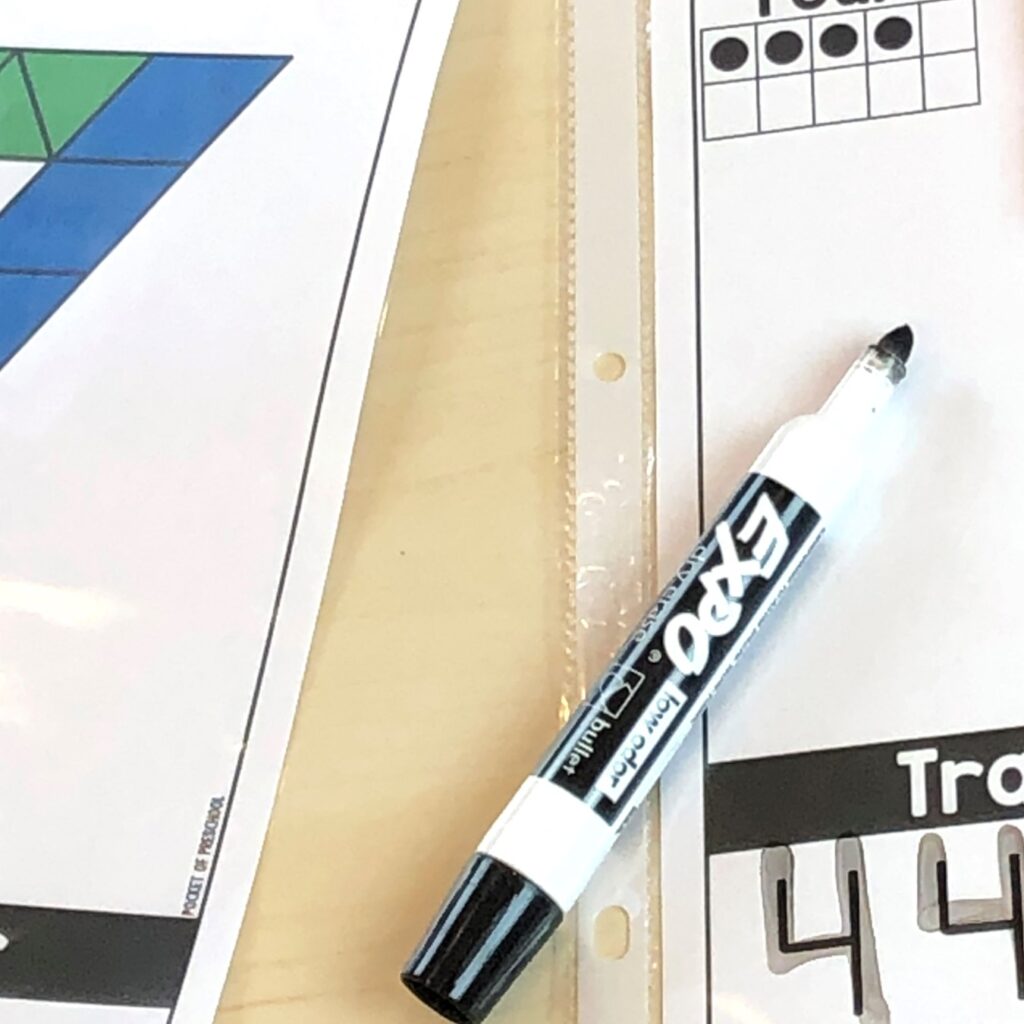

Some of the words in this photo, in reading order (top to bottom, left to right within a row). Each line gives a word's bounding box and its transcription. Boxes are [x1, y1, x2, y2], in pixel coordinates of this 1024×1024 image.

[663, 491, 790, 676] EXPO
[646, 690, 681, 730] low
[562, 716, 612, 776] bullet
[610, 734, 647, 788] odor
[181, 875, 204, 917] POCKET
[194, 858, 209, 872] OF
[761, 834, 890, 1024] 4
